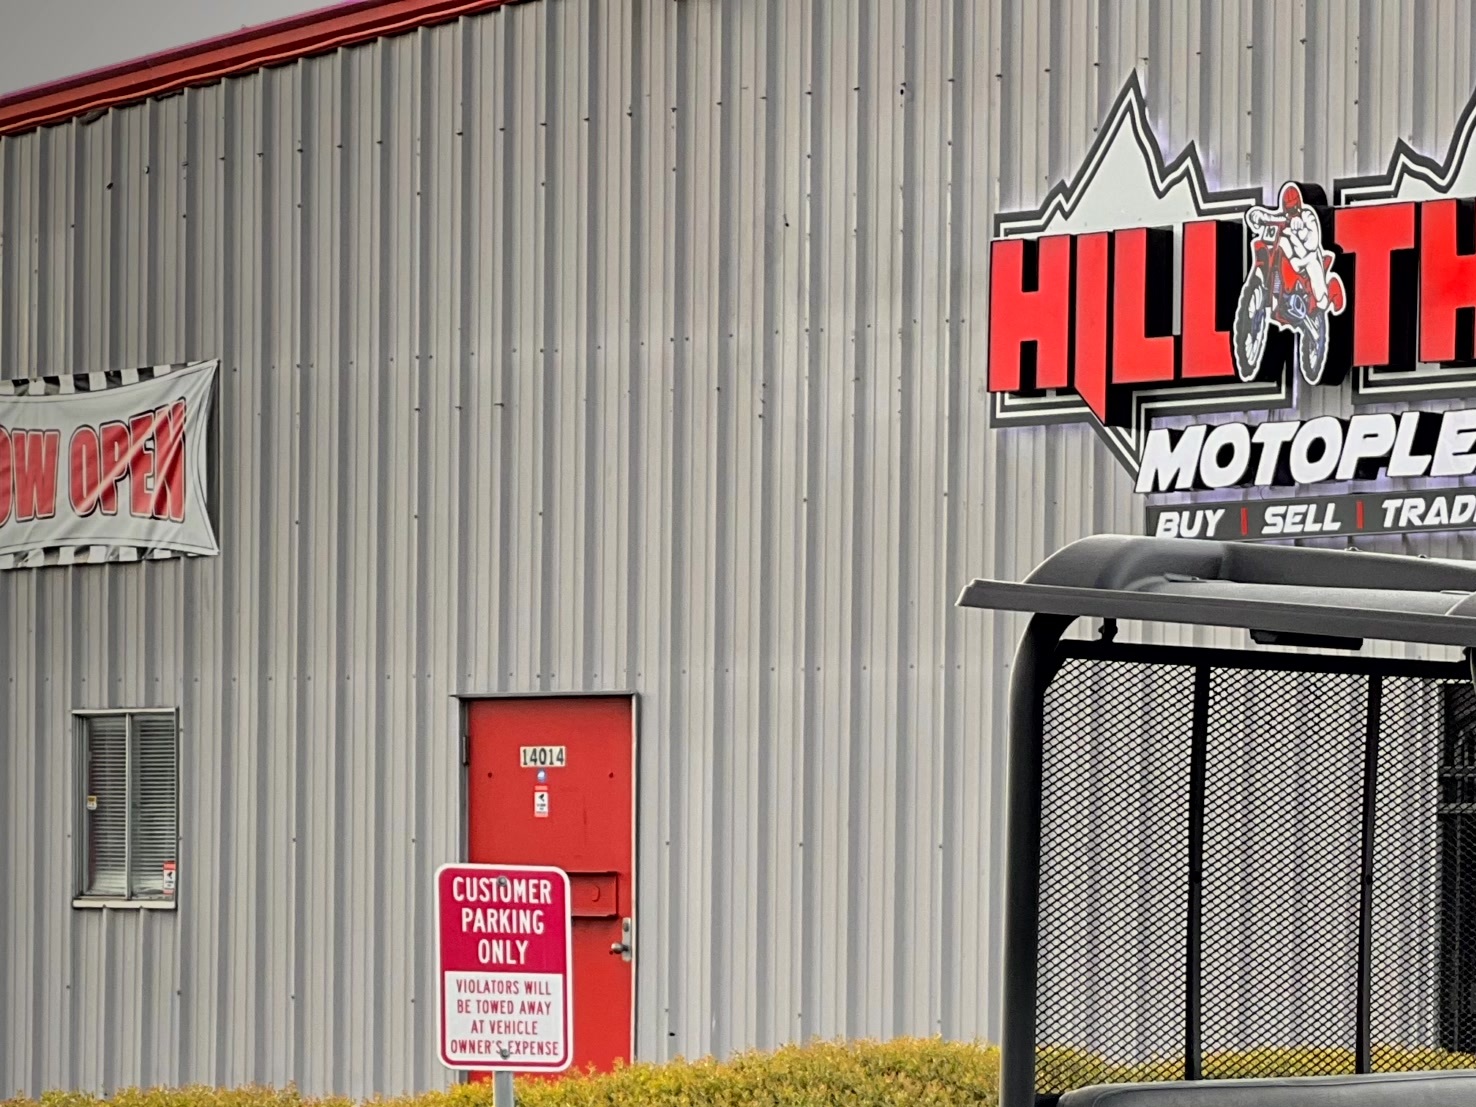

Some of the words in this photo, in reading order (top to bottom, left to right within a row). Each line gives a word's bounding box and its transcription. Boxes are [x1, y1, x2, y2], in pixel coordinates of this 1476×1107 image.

[988, 219, 1236, 427] HILL
[69, 396, 186, 523] OPEN
[1155, 509, 1225, 537] BUY
[1261, 503, 1342, 535] SELL
[523, 748, 564, 765] 14014
[452, 876, 552, 904] CUSTOMER
[461, 907, 545, 935] PARKING
[477, 939, 529, 965] ONLY
[456, 979, 519, 995] VIOLATORS
[524, 981, 552, 996] WILL
[457, 1000, 471, 1014] BE
[476, 1000, 514, 1015] TOWED
[519, 1001, 551, 1016] AWAY
[471, 1020, 485, 1034] AT
[489, 1020, 538, 1035] VEHICLE
[450, 1040, 503, 1055] OWNER'S
[508, 1041, 559, 1056] EXPENSE
